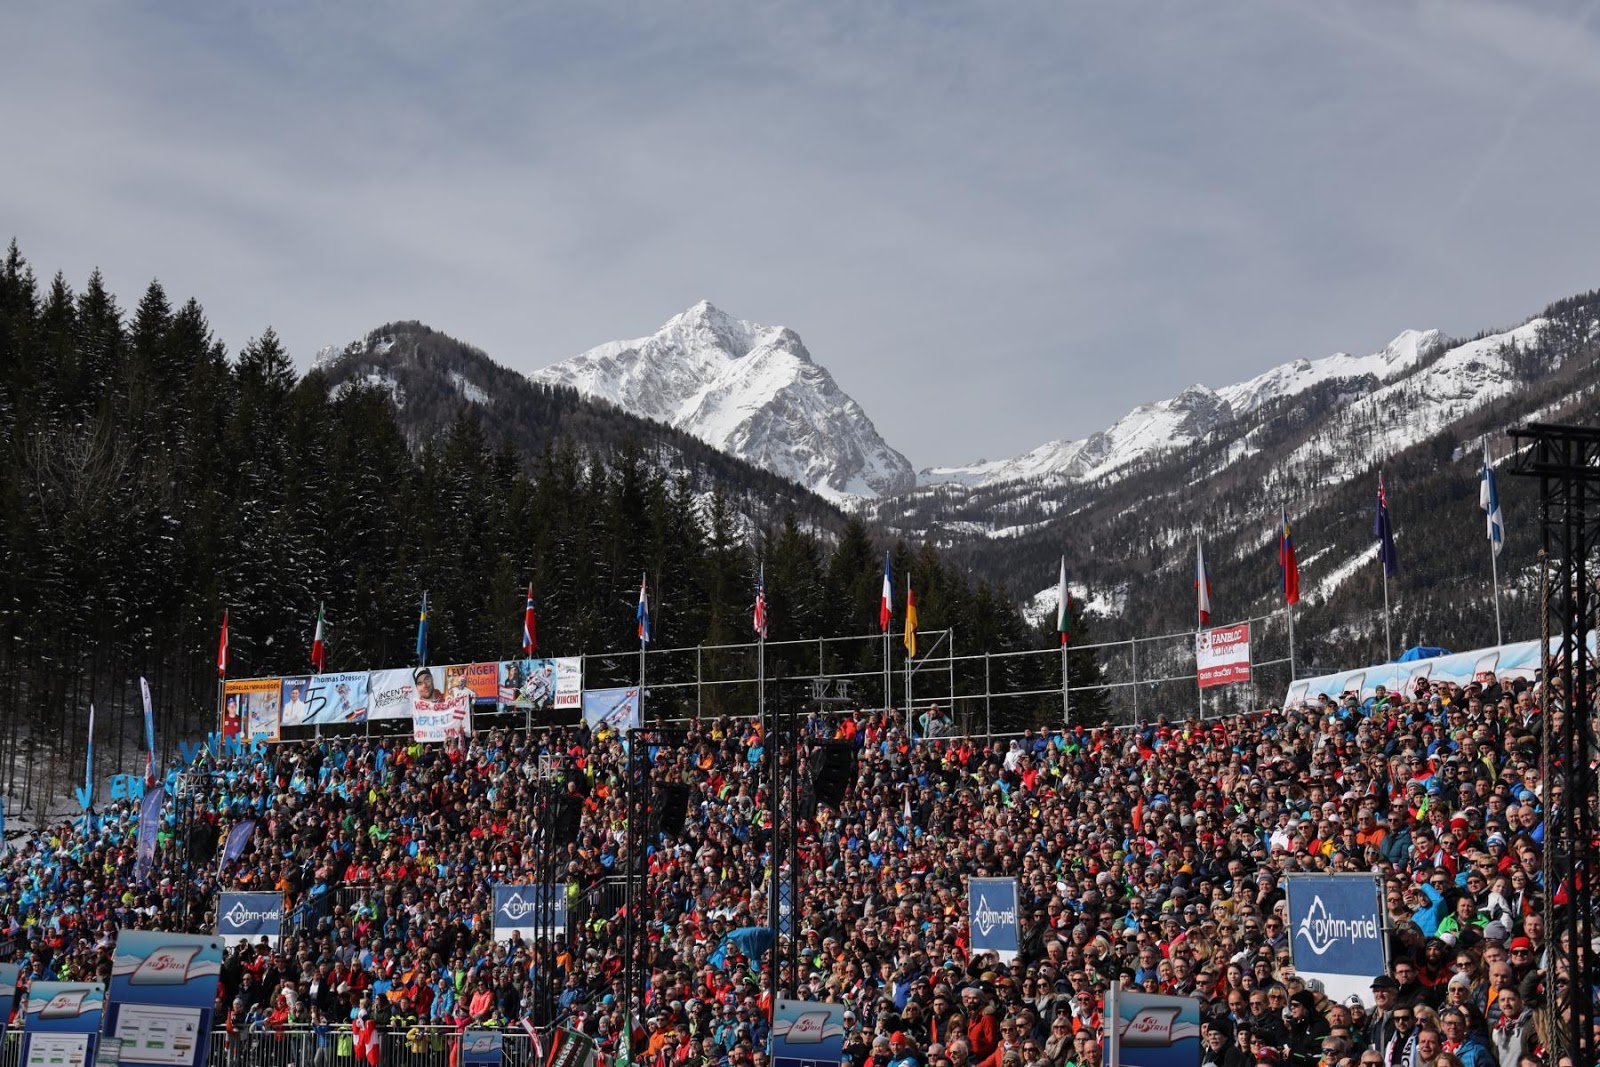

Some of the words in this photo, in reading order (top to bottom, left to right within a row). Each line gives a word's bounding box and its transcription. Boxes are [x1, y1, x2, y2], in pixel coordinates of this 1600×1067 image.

[314, 675, 339, 683] Thomas
[340, 674, 366, 682] Dressen
[556, 695, 579, 704] VINCENT
[235, 909, 279, 923] pyhrn-priel
[1315, 912, 1378, 945] pyhrn-priel
